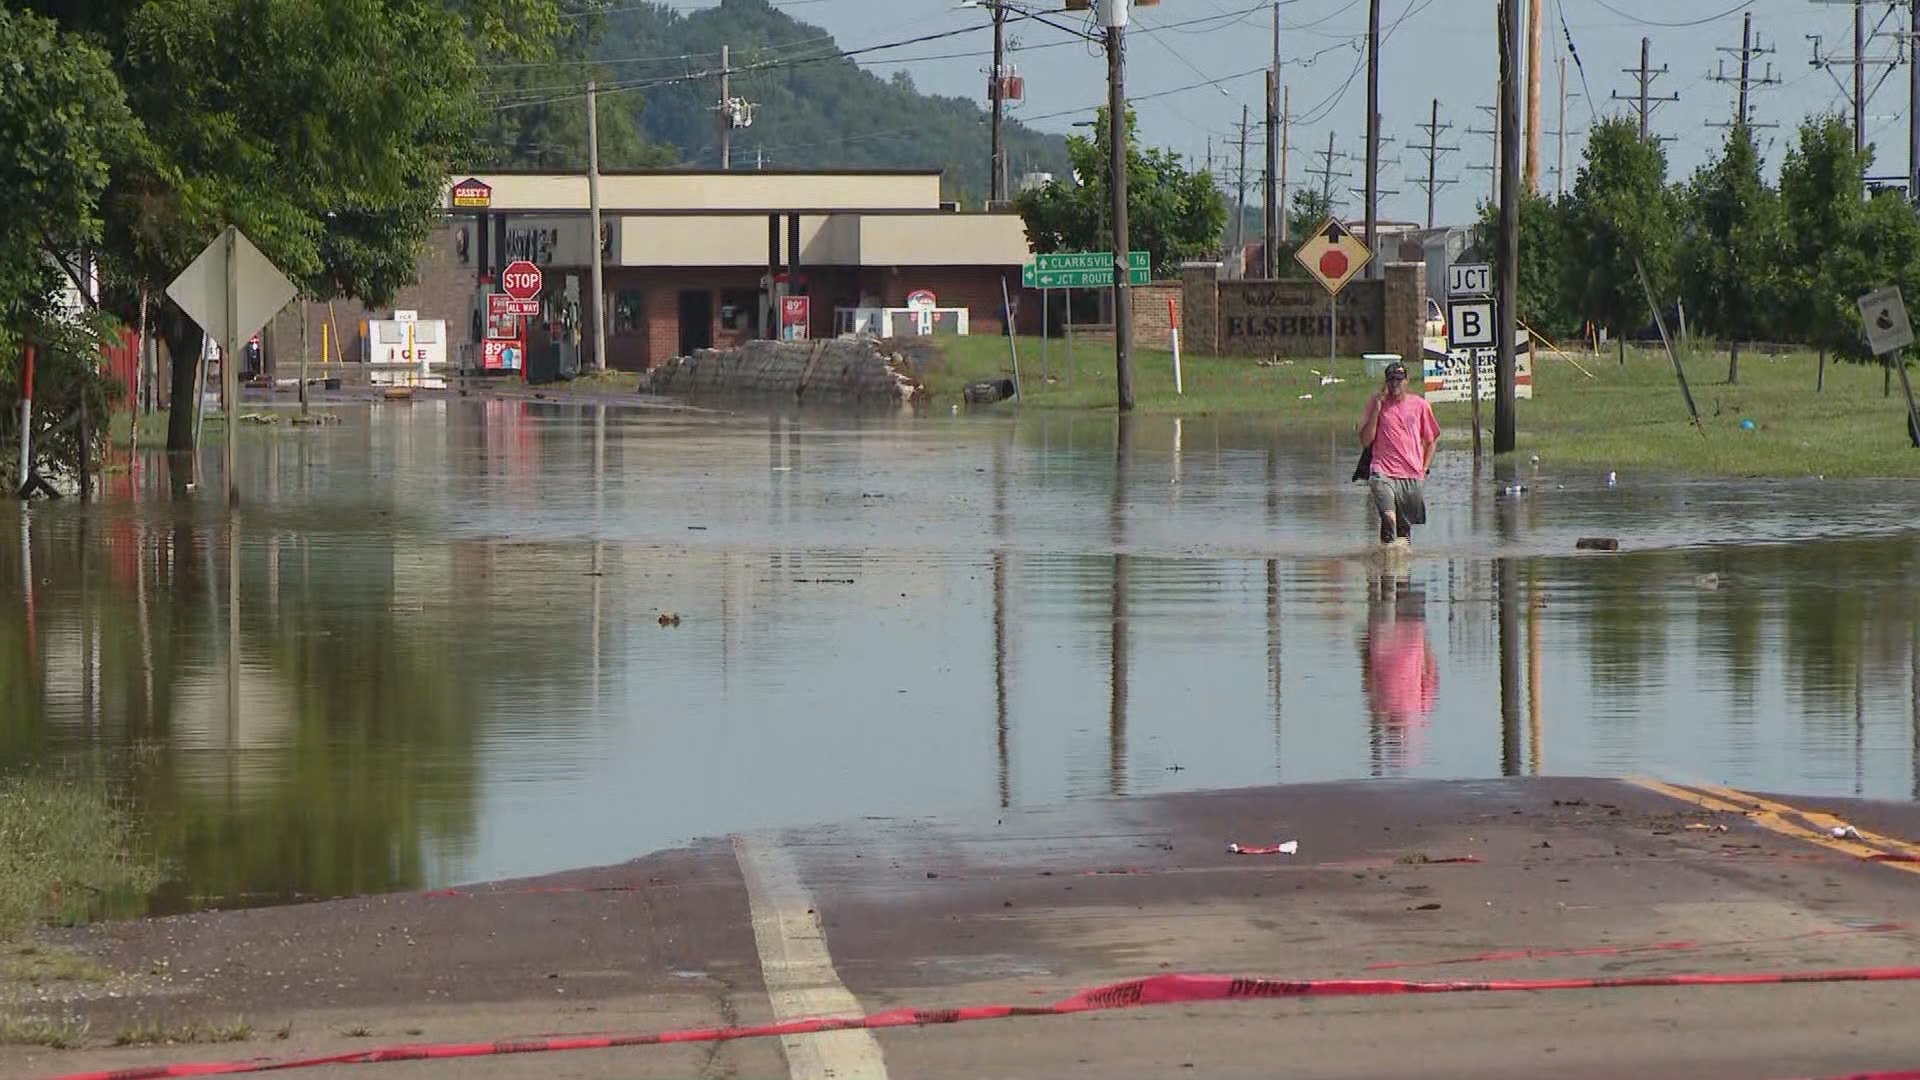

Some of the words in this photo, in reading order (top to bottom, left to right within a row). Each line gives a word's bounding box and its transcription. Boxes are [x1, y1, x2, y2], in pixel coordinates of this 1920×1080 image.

[456, 188, 488, 197] CASEY'S
[1051, 256, 1114, 268] CLARKSVIL
[1136, 255, 1146, 266] 16
[506, 273, 539, 289] STOP
[1056, 274, 1077, 285] JCT.
[1082, 272, 1113, 284] ROUTE
[1139, 272, 1148, 282] 11
[1452, 269, 1488, 290] JCT
[508, 303, 521, 313] ALL
[523, 303, 538, 313] WAY
[1229, 315, 1372, 337] ELSBERRY
[1462, 311, 1481, 338] B
[390, 349, 427, 361] ICE
[1434, 354, 1497, 371] CONER
